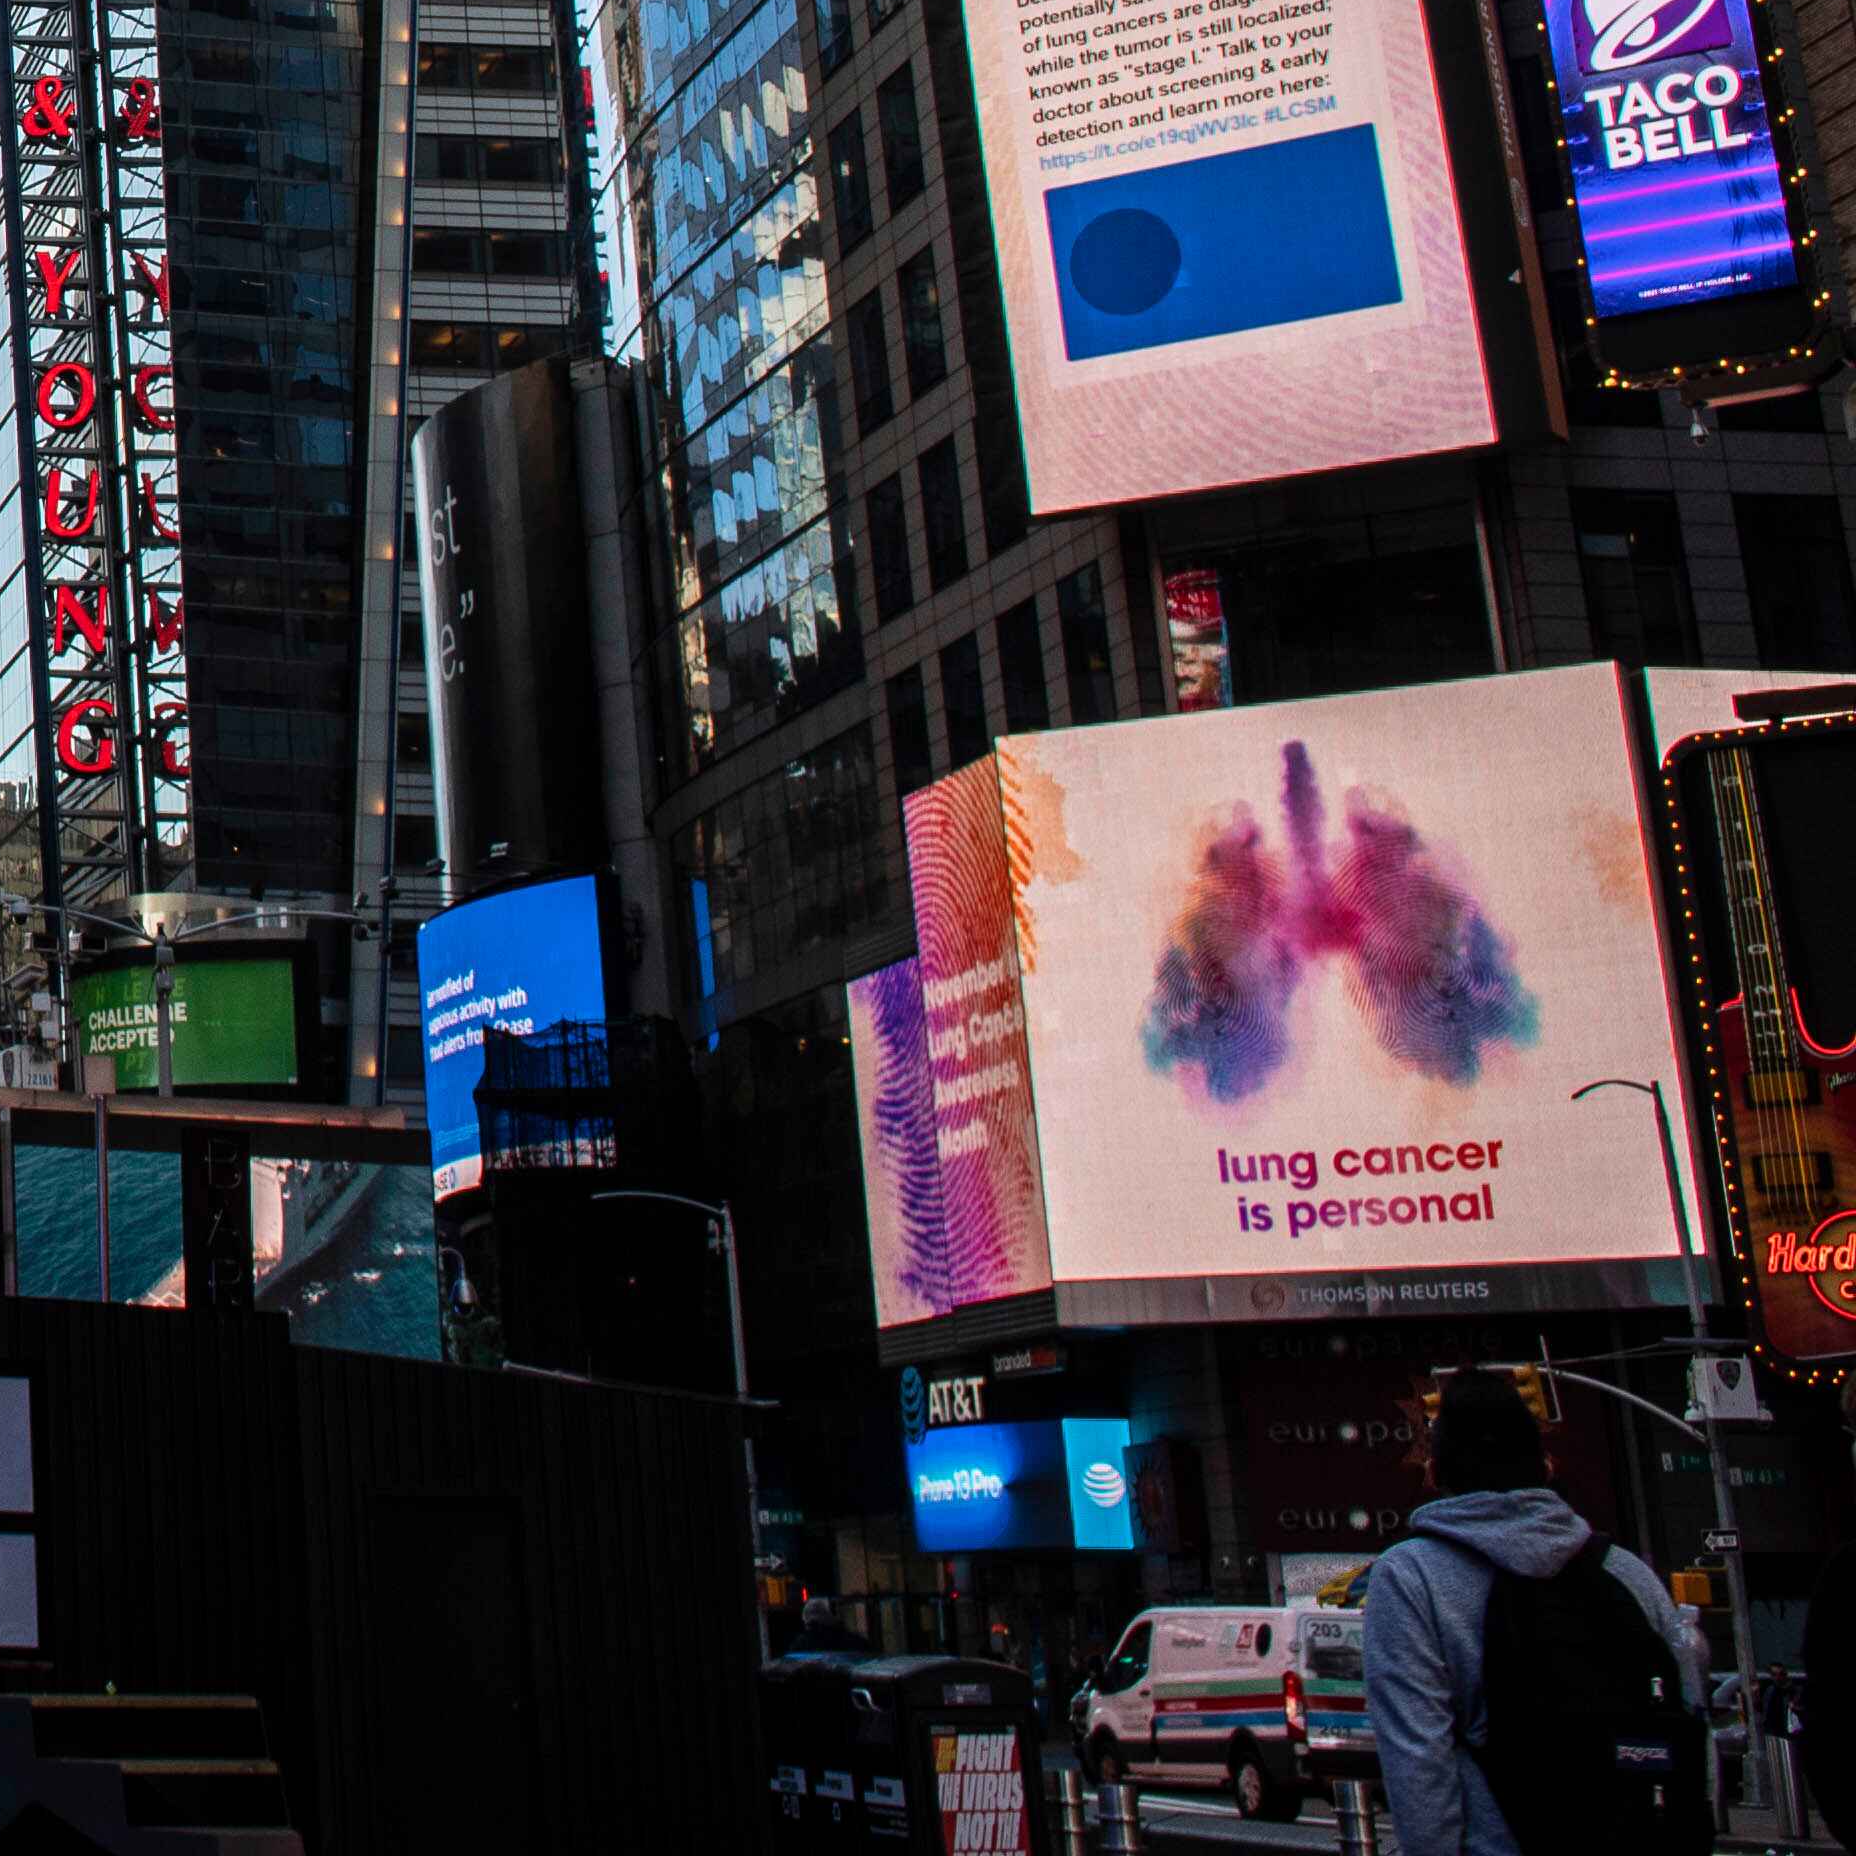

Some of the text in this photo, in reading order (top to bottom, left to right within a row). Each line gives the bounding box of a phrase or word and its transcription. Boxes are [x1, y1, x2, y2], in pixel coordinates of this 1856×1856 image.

[1019, 0, 1117, 35] potentially
[1022, 35, 1044, 54] of
[1045, 28, 1089, 50] lung
[1092, 9, 1168, 39] cancers
[1173, 2, 1204, 21] are
[1026, 55, 1075, 77] while
[1079, 47, 1110, 66] the
[1114, 33, 1172, 58] tumor
[1176, 28, 1194, 44] is
[1198, 16, 1234, 39] still
[1029, 74, 1092, 101] known
[1097, 70, 1120, 88] as
[1217, 38, 1257, 60] Talk
[1262, 34, 1282, 50] to
[1286, 22, 1333, 48] your
[21, 74, 75, 140] &
[1033, 48, 1330, 124] doctor about screening & early
[1264, 95, 1338, 123] #LCSM
[1584, 64, 1742, 128] TACO
[1036, 74, 1333, 148] detection and learn more here:
[1603, 108, 1749, 170] BELL
[34, 250, 115, 777] YOUNG
[498, 985, 529, 1012] with
[922, 959, 1004, 1008] November
[88, 1001, 188, 1030] CHALLENE
[89, 1027, 175, 1054] ACCEPTE
[926, 1024, 968, 1062] Lung
[933, 1060, 1019, 1112] Awareness
[1217, 1138, 1504, 1192] lung cancer
[1237, 1183, 1496, 1240] is personal
[1767, 1231, 1856, 1275] Hard
[1298, 1280, 1490, 1304] THOMSON REUTERS
[929, 1375, 986, 1425] AT&T
[971, 1466, 1004, 1499] Pro
[1310, 1623, 1342, 1638] 203
[954, 1733, 1017, 1772] FIGHT
[962, 1771, 1025, 1811] VIRUS
[953, 1811, 997, 1851] NOT
